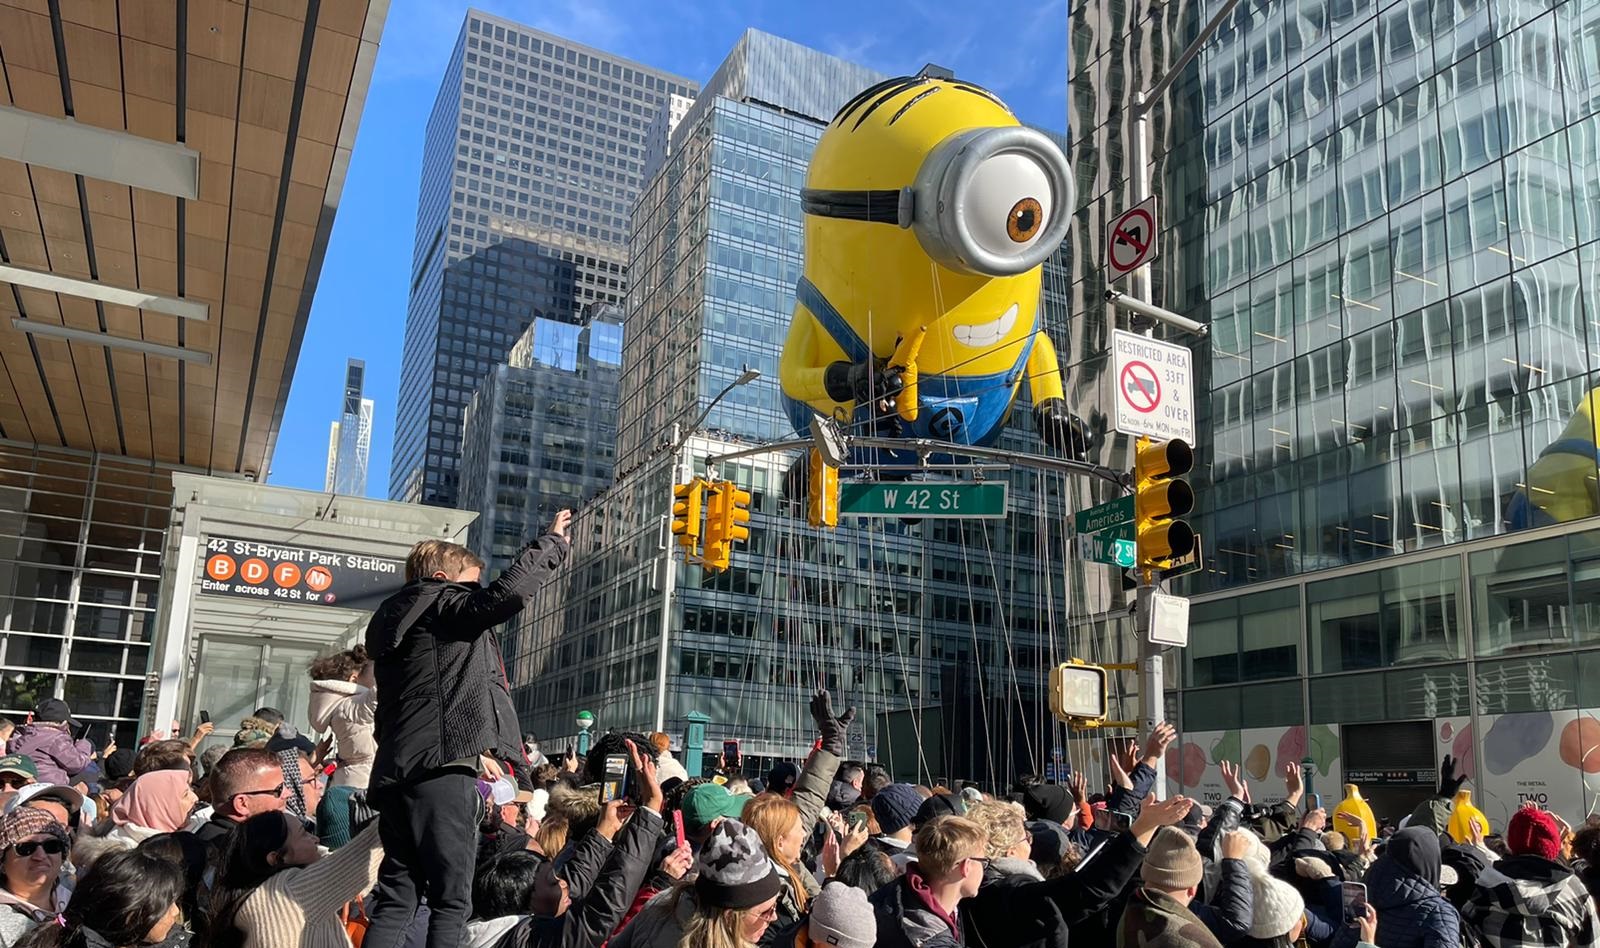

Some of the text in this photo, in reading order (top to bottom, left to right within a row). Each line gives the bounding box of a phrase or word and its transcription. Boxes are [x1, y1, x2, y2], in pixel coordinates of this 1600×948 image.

[1118, 340, 1187, 368] RESTRICTED AREA
[1165, 370, 1185, 385] 33 FT
[1173, 389, 1180, 402] &
[1165, 405, 1189, 422] OVER
[1155, 421, 1170, 433] MON
[883, 489, 960, 510] W 42 St
[1086, 510, 1125, 532] Americas
[207, 539, 396, 574] 42 St-Bryant Park Station
[1093, 539, 1104, 560] W
[1107, 541, 1123, 563] 42
[1125, 544, 1134, 558] St
[214, 560, 326, 586] B D F M
[202, 579, 230, 592] Enter
[235, 585, 269, 596] across
[274, 587, 289, 598] 42
[289, 589, 301, 599] St
[306, 591, 320, 601] for
[851, 733, 863, 742] 25
[1203, 793, 1222, 801] TWO
[1517, 793, 1548, 804] TWO
